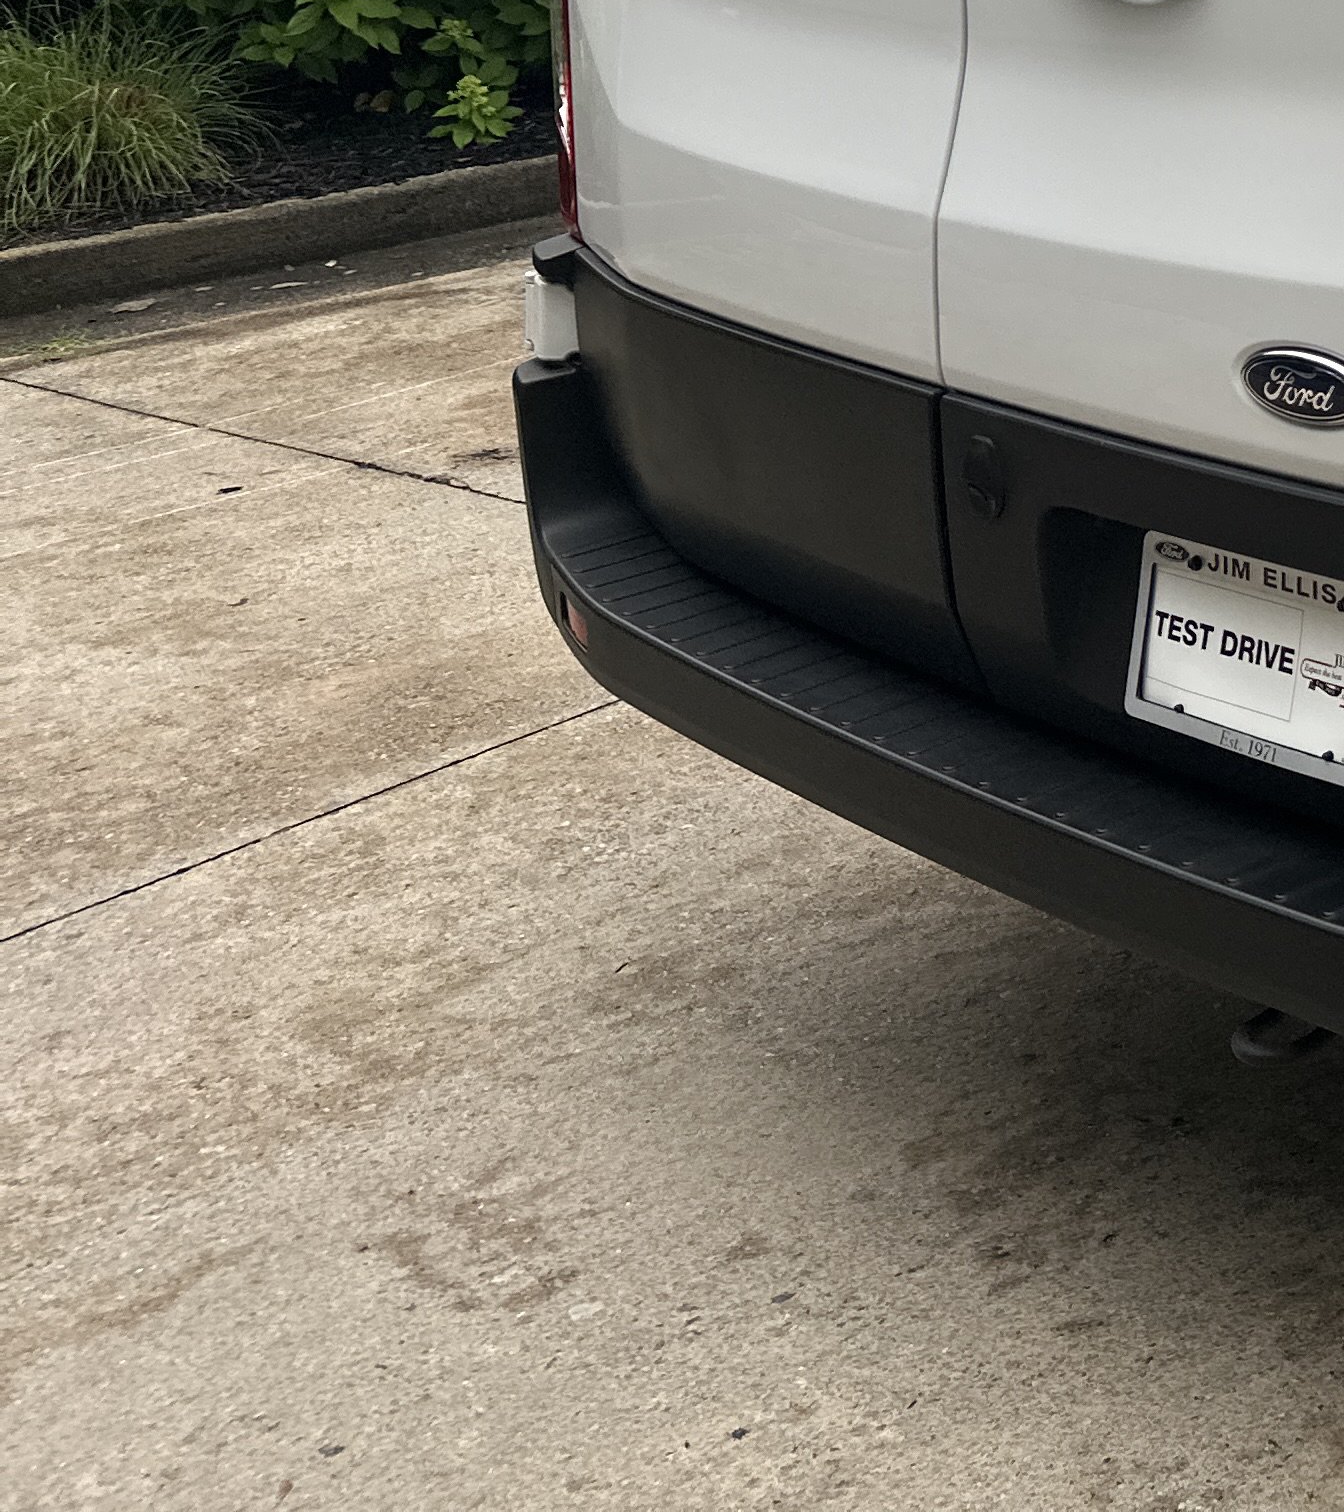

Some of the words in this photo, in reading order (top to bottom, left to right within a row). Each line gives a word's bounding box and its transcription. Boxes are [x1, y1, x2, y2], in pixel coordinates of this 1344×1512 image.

[1263, 364, 1336, 412] Ford
[1207, 553, 1251, 581] JIM
[1263, 567, 1337, 604] ELLIS
[1155, 609, 1214, 650] TEST
[1220, 629, 1295, 676] DRIVE
[1219, 729, 1243, 752] Est.
[1247, 739, 1277, 763] 1971
